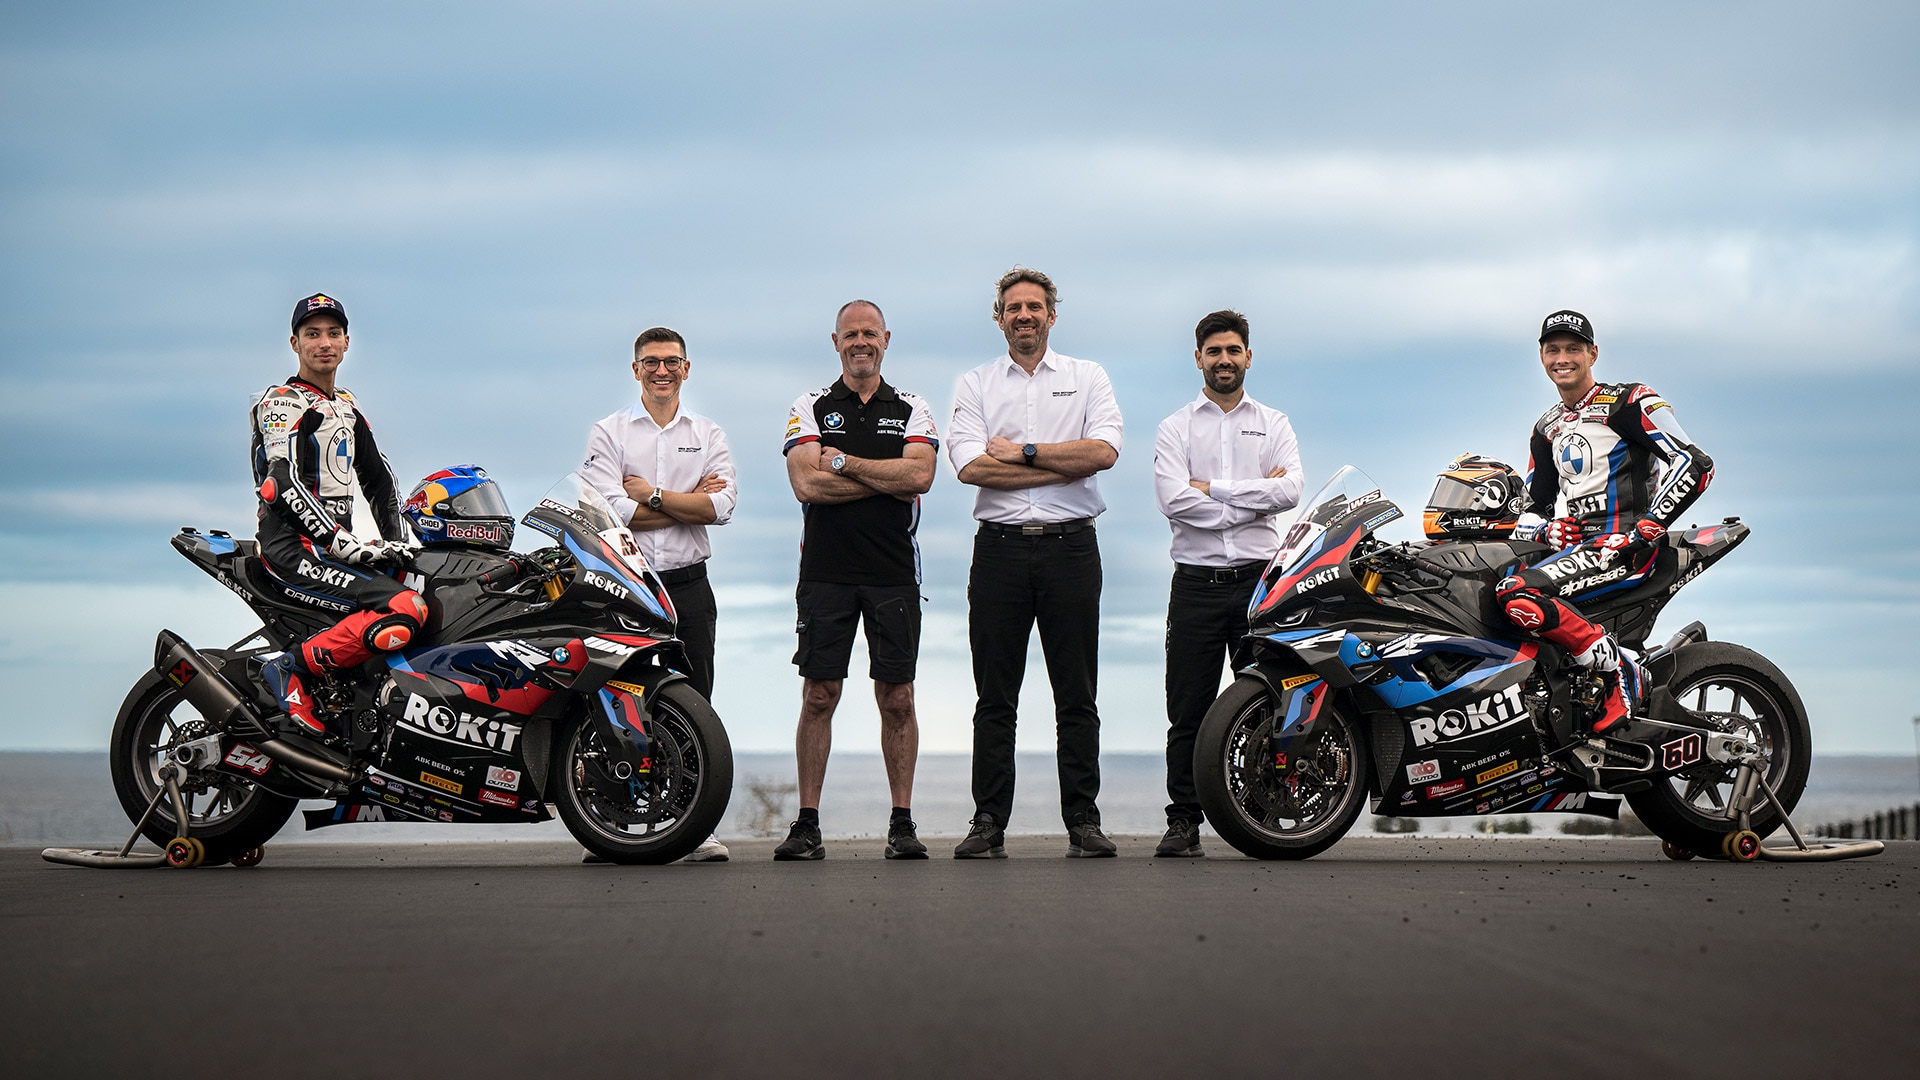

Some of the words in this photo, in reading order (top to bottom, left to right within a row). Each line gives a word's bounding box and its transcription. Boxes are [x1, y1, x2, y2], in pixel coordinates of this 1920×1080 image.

[263, 411, 288, 422] ebc
[420, 518, 439, 528] SHOEI
[447, 524, 474, 539] Red
[475, 526, 501, 541] Bull
[1548, 550, 1602, 581] ROKi
[1559, 566, 1627, 596] alpinestars
[284, 587, 351, 614] DAINESE
[1285, 674, 1319, 688] PIRELLI
[224, 744, 273, 775] 54
[1662, 733, 1701, 770] 60
[415, 756, 431, 765] ABK
[431, 760, 451, 772] BEER
[1461, 762, 1477, 771] ABK
[1477, 754, 1497, 766] BEER
[1411, 773, 1439, 783] OUTDO
[1480, 763, 1516, 782] PIRELLI
[423, 774, 459, 793] PIRELLI
[488, 780, 516, 789] OUTDO
